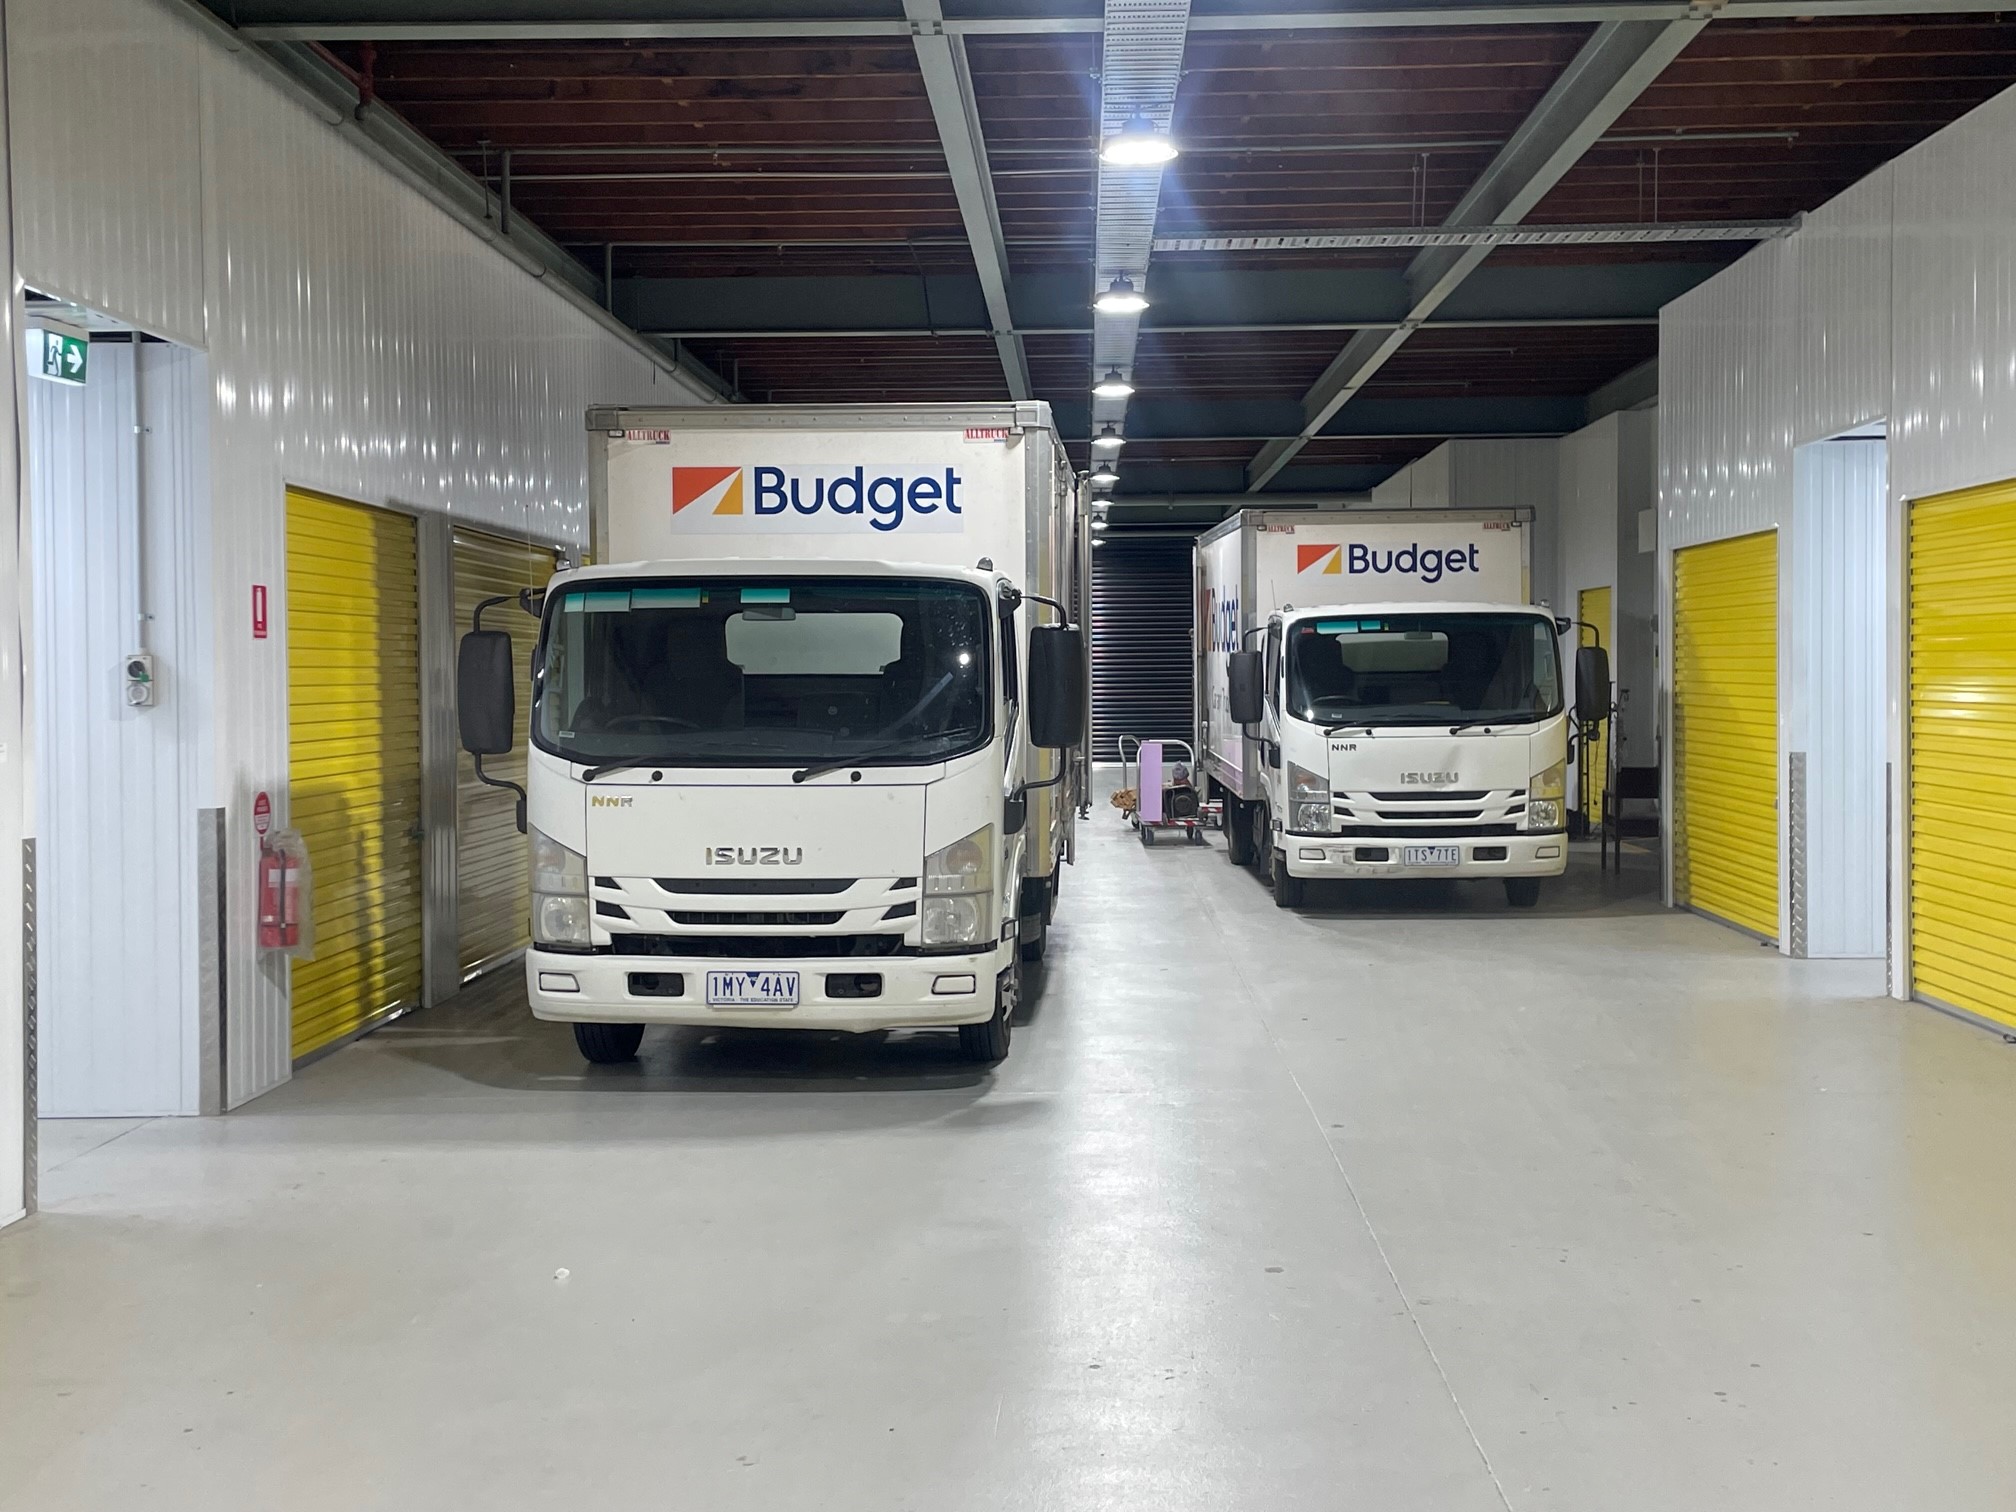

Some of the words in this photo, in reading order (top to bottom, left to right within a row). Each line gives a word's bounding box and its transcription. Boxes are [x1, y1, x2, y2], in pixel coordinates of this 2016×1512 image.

[627, 428, 670, 441] ALLTRUCK
[964, 427, 1009, 439] ALLTRUCK
[754, 465, 962, 531] Budget
[1348, 542, 1480, 583] Budget
[1331, 743, 1358, 752] NNR
[1400, 772, 1460, 784] ISUZU
[591, 795, 633, 808] NNR
[705, 846, 803, 866] ISUZU
[1408, 849, 1428, 861] 1TS
[1436, 848, 1457, 861] 7TE
[713, 976, 746, 997] 1MY
[760, 976, 796, 997] 4AV
